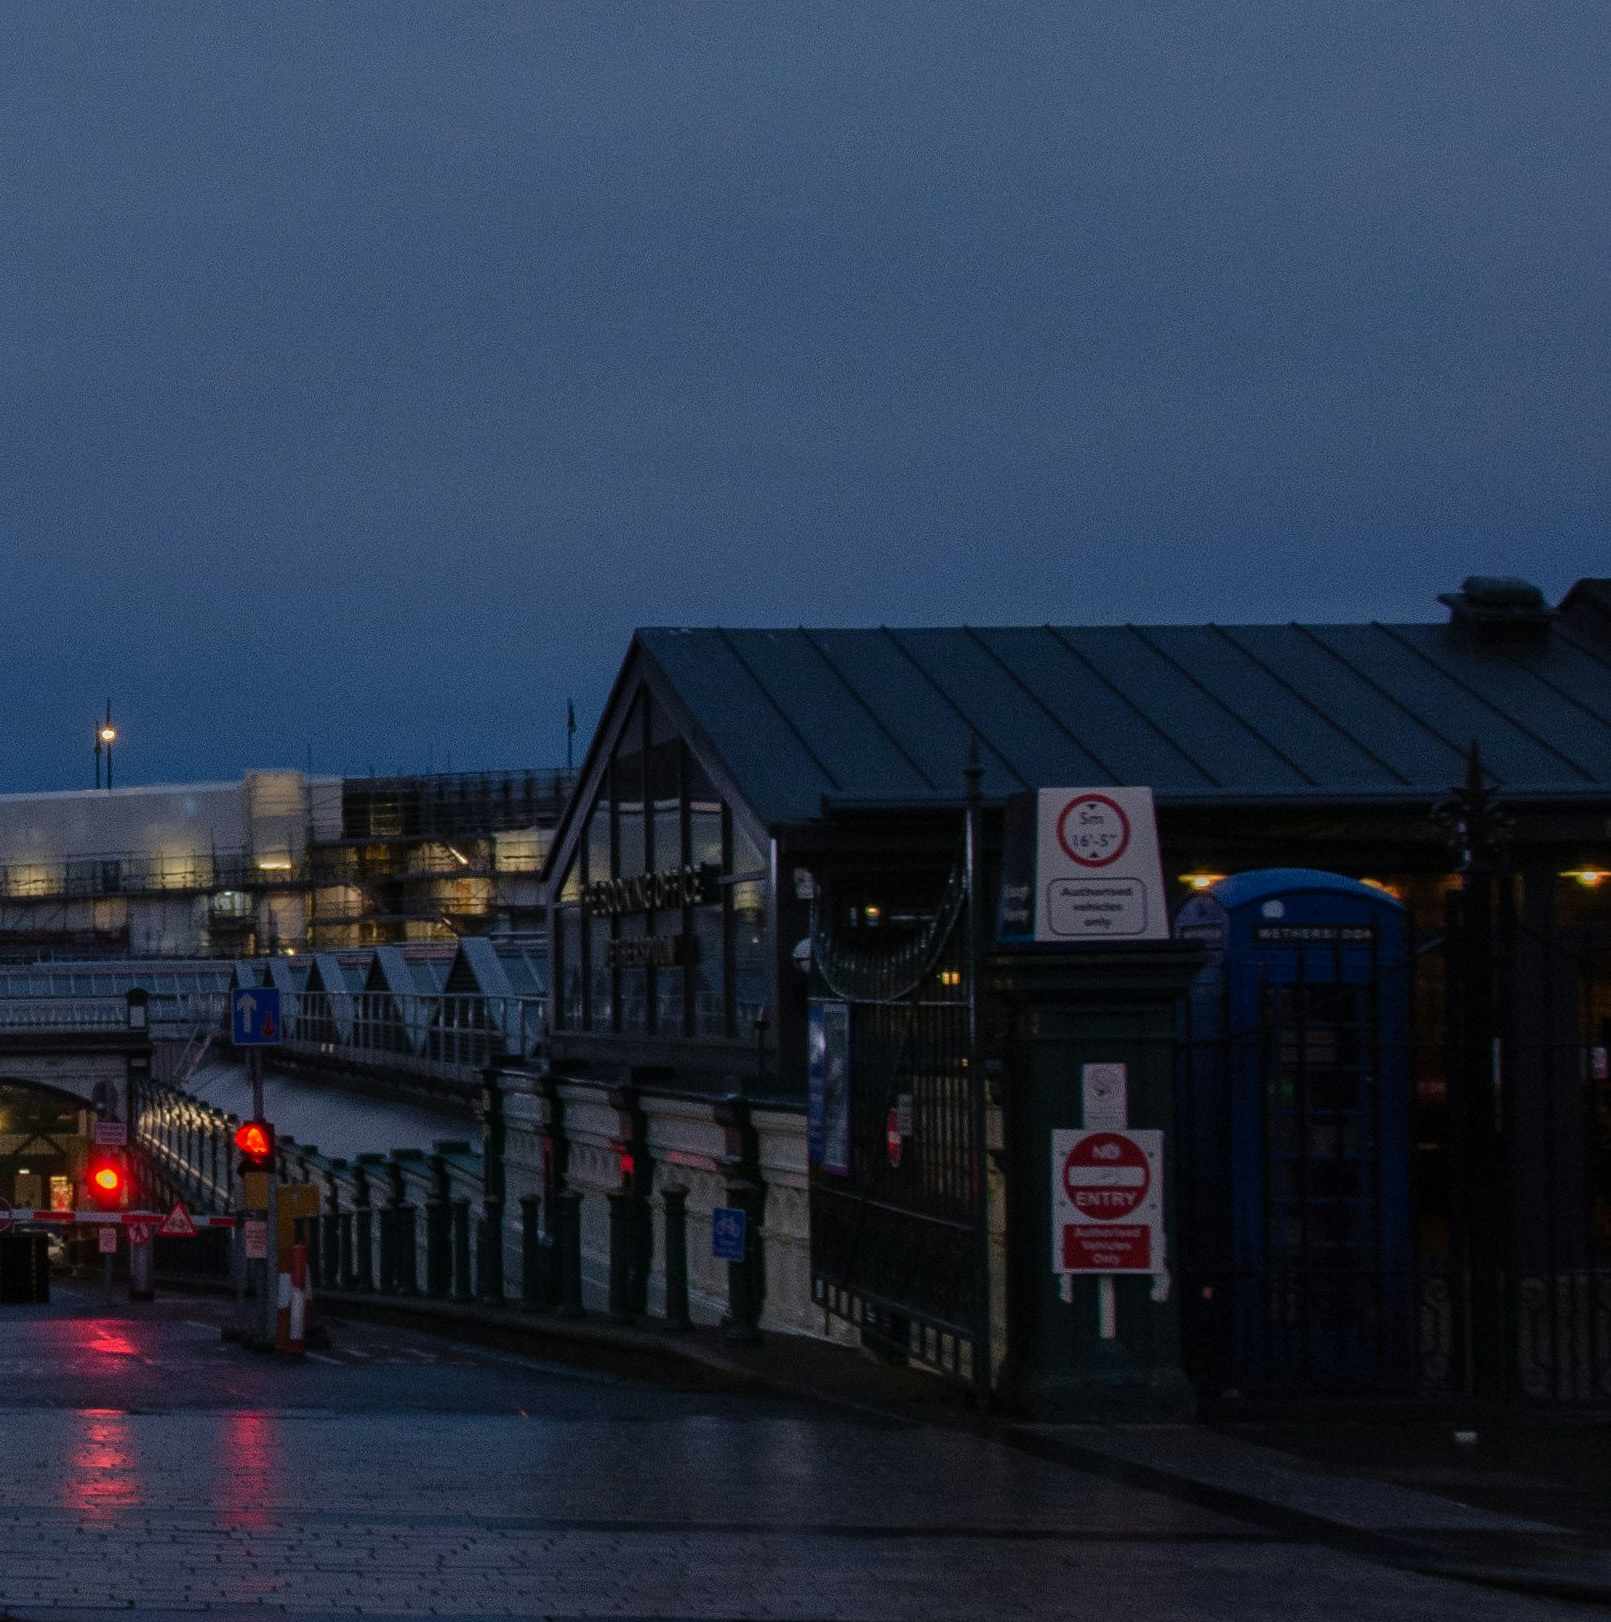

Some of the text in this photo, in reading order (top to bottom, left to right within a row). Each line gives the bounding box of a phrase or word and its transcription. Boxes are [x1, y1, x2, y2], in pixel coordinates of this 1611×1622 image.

[1079, 811, 1105, 826] 5m
[1091, 1142, 1123, 1161] NO
[1075, 1191, 1137, 1207] ENTRY
